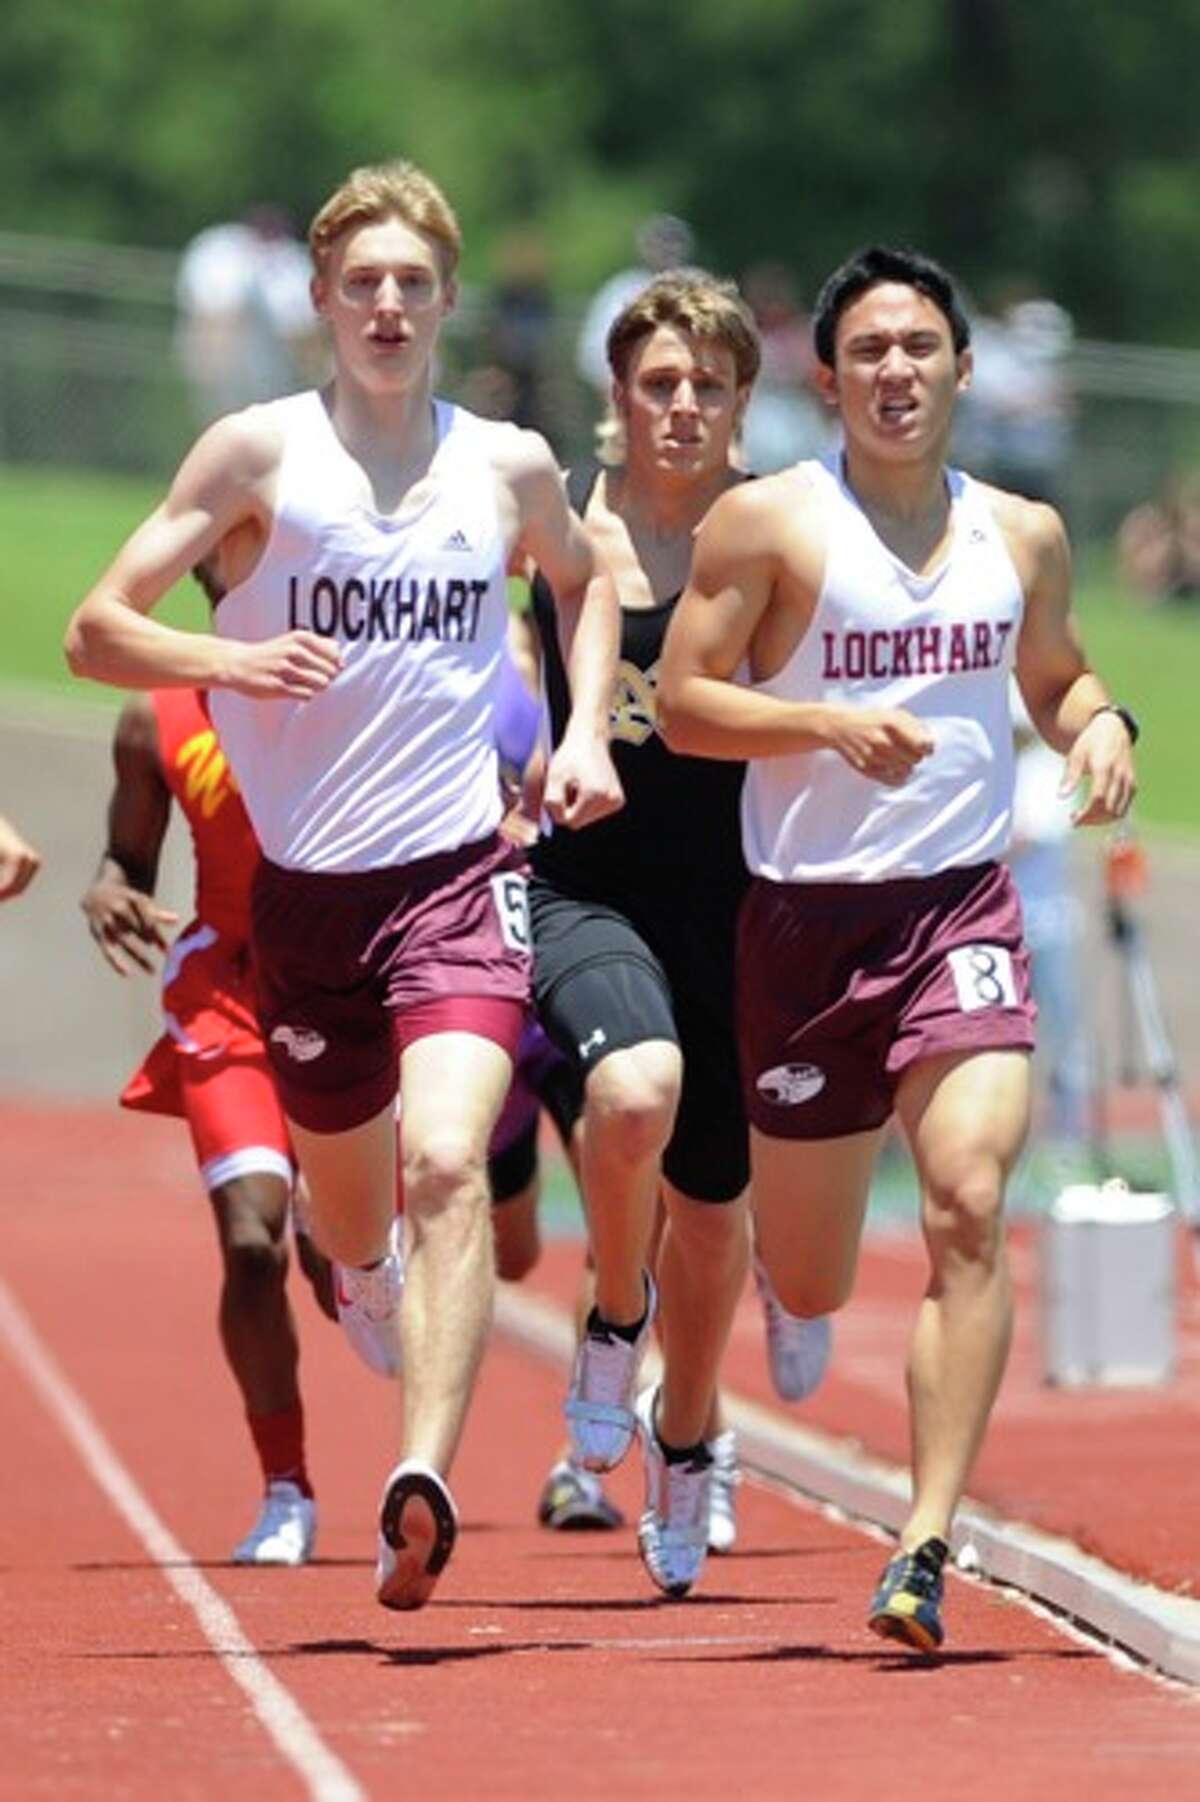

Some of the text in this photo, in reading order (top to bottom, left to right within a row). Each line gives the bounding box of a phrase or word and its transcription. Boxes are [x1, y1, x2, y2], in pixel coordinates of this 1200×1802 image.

[289, 576, 489, 642] LOCKHART
[821, 620, 1012, 680] LOCKHART
[969, 946, 1005, 1005] 8
